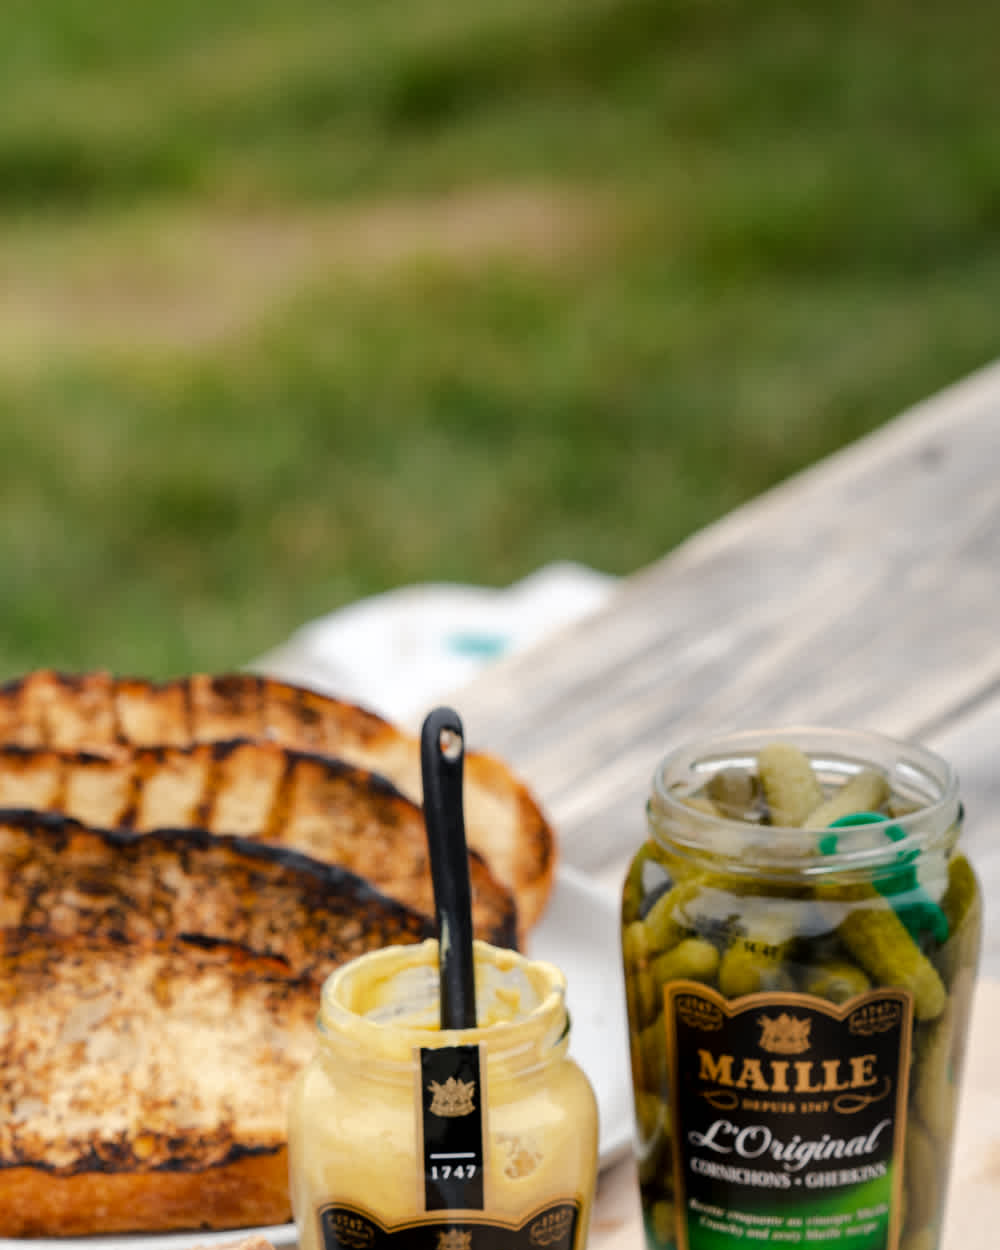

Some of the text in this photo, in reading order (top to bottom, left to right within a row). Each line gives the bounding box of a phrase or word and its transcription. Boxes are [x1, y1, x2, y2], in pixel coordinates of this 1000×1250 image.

[697, 1049, 878, 1093] MAILLE
[688, 1119, 892, 1172] L'Original
[430, 1164, 477, 1180] 1747
[690, 1157, 887, 1189] CORNICHONS GHERKINS
